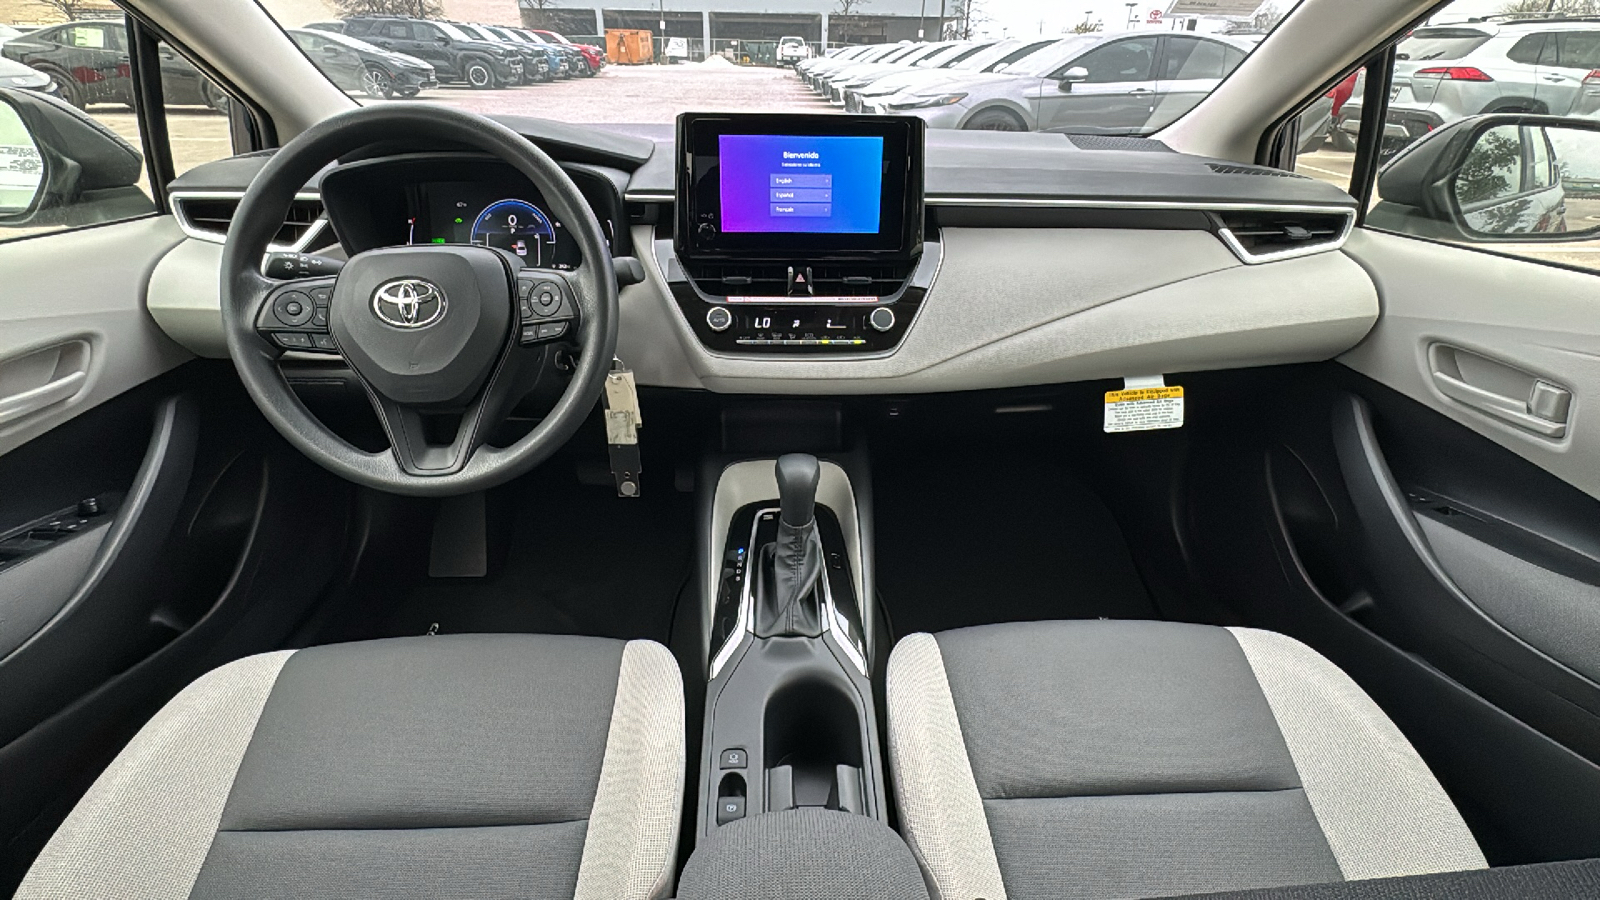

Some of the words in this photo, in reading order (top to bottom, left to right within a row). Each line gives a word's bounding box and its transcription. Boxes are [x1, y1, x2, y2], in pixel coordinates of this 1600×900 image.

[783, 151, 819, 159] Bienvenido
[508, 214, 517, 226] 0
[754, 317, 771, 328] LO
